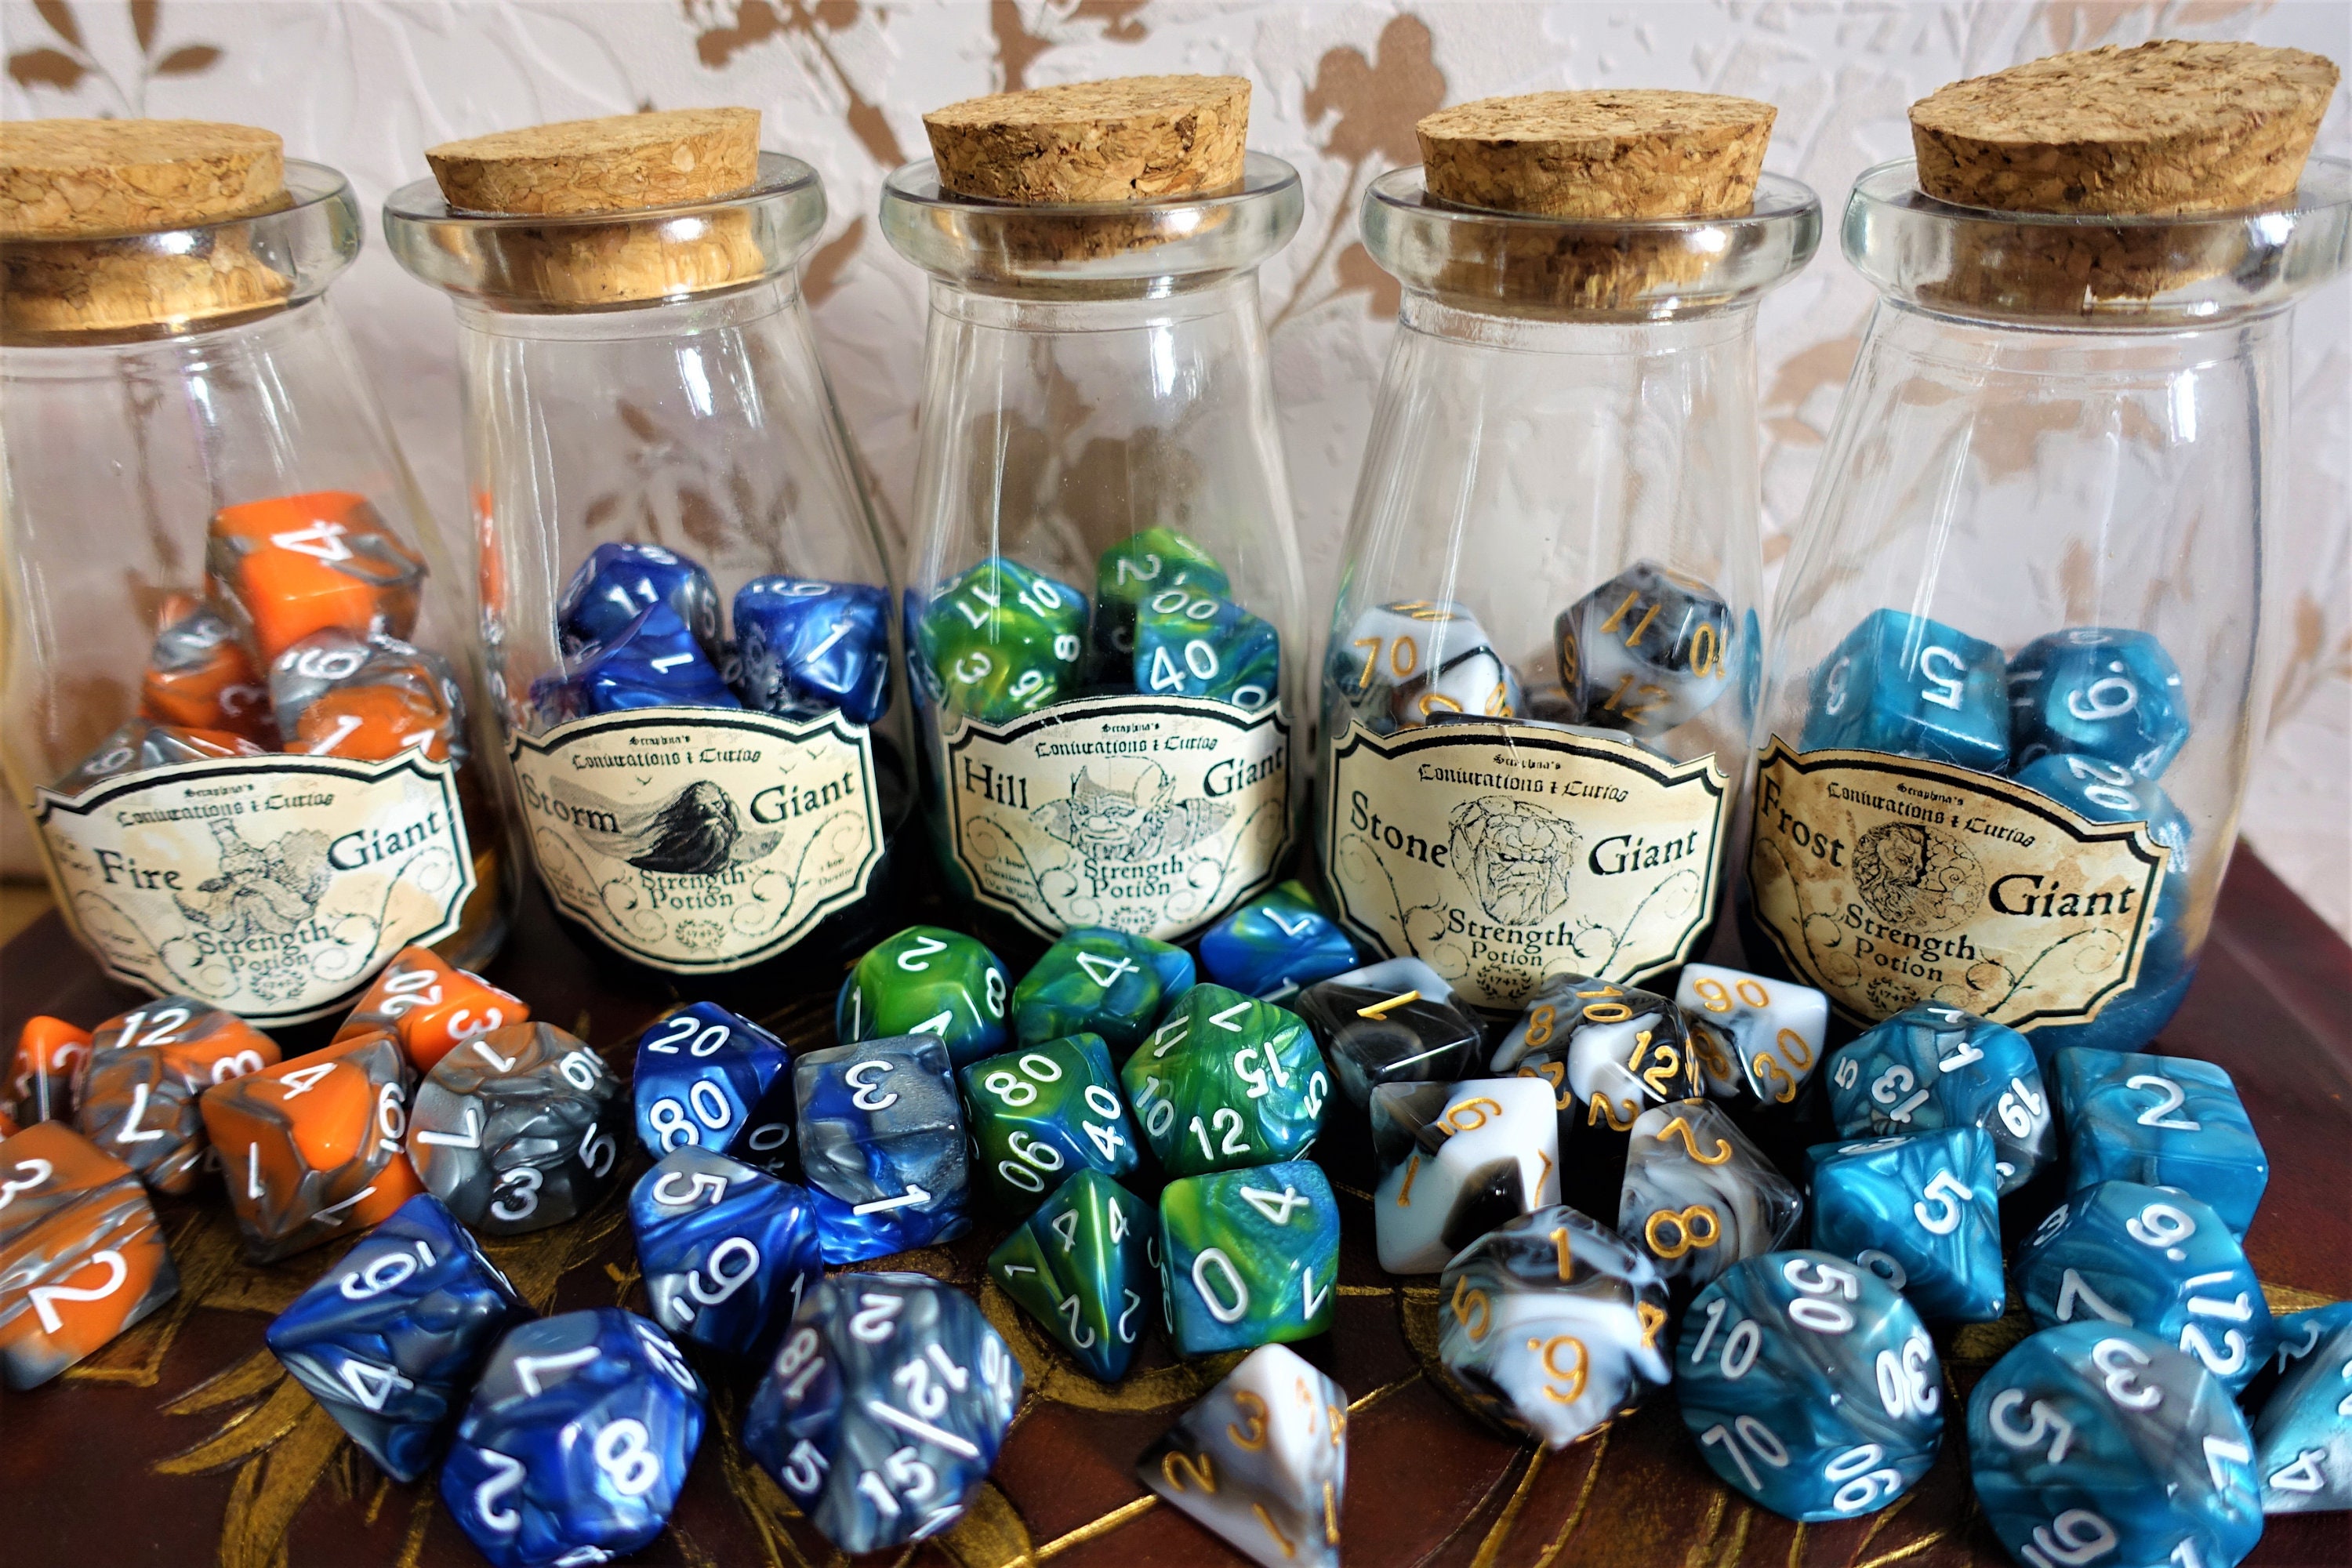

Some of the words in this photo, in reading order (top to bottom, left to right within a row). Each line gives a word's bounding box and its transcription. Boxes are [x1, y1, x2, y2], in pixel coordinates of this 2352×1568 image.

[270, 519, 354, 561] 4
[651, 652, 695, 674] 1
[1150, 640, 1219, 692] 40
[1354, 636, 1417, 689] 70
[521, 773, 622, 833] Storm
[750, 769, 855, 824] Giant
[964, 757, 1029, 810] Hill
[1202, 746, 1285, 798] Giant
[93, 848, 183, 891] Fire
[328, 811, 441, 871] Giant
[1351, 789, 1451, 869] Stone
[1588, 829, 1700, 877] Giant
[1761, 777, 1846, 869] Frost
[1988, 873, 2136, 920] Giant
[640, 865, 746, 895] Strength
[1084, 854, 1183, 884] Strength
[1091, 877, 1170, 898] Potion
[651, 888, 734, 909] Potion
[193, 919, 332, 956] Strength
[898, 935, 948, 972] 2
[1447, 909, 1573, 954] Strength
[1471, 940, 1542, 966] Potion
[1844, 903, 1976, 963] Strength
[227, 954, 310, 973] Potion
[1076, 952, 1140, 987] 4
[1854, 935, 1943, 982] Potion
[986, 967, 1007, 1019] 8
[1575, 985, 1633, 1022] 10
[1693, 978, 1769, 1013] 90
[115, 1007, 190, 1048] 12
[648, 1017, 730, 1057] 20
[1525, 1004, 1555, 1046] 8
[280, 1062, 337, 1099] 4
[985, 1054, 1062, 1107] 80
[1234, 1042, 1290, 1098] 15
[1628, 1030, 1679, 1095] 12
[1753, 1028, 1813, 1103] 30
[1939, 1043, 1985, 1073] 1
[845, 1060, 898, 1111] 3
[1588, 1092, 1639, 1131] 2
[1871, 1064, 1929, 1123] 13
[2126, 1074, 2201, 1131] 2
[649, 1080, 731, 1153] 80
[1082, 1084, 1126, 1162] 40
[1189, 1108, 1250, 1161] 12
[1657, 1117, 1732, 1164] 2
[579, 1123, 617, 1178] 5
[491, 1167, 543, 1221] 3
[652, 1171, 728, 1206] 5
[853, 1184, 931, 1215] 1
[1240, 1185, 1311, 1226] 4
[1914, 1169, 1973, 1235] 5
[1052, 1208, 1080, 1254] 4
[1108, 1196, 1131, 1245] 4
[1646, 1204, 1720, 1258] 8
[1549, 1227, 1573, 1282] 1
[28, 1250, 128, 1334] 2
[1192, 1247, 1249, 1324] 0
[1451, 1275, 1490, 1341] 5
[1783, 1258, 1859, 1333] 50
[849, 1294, 904, 1343] 2
[1059, 1294, 1095, 1349] 2
[1692, 1298, 1761, 1380] 10
[340, 1358, 416, 1411] 4
[1875, 1335, 1940, 1419] 30
[2091, 1338, 2164, 1410] 3
[1701, 1415, 1790, 1491] 70
[1989, 1388, 2073, 1465] 5
[593, 1418, 660, 1495] 8
[857, 1446, 938, 1519] 15
[1160, 1450, 1214, 1493] 2
[2269, 1448, 2327, 1492] 4
[475, 1448, 527, 1532] 2
